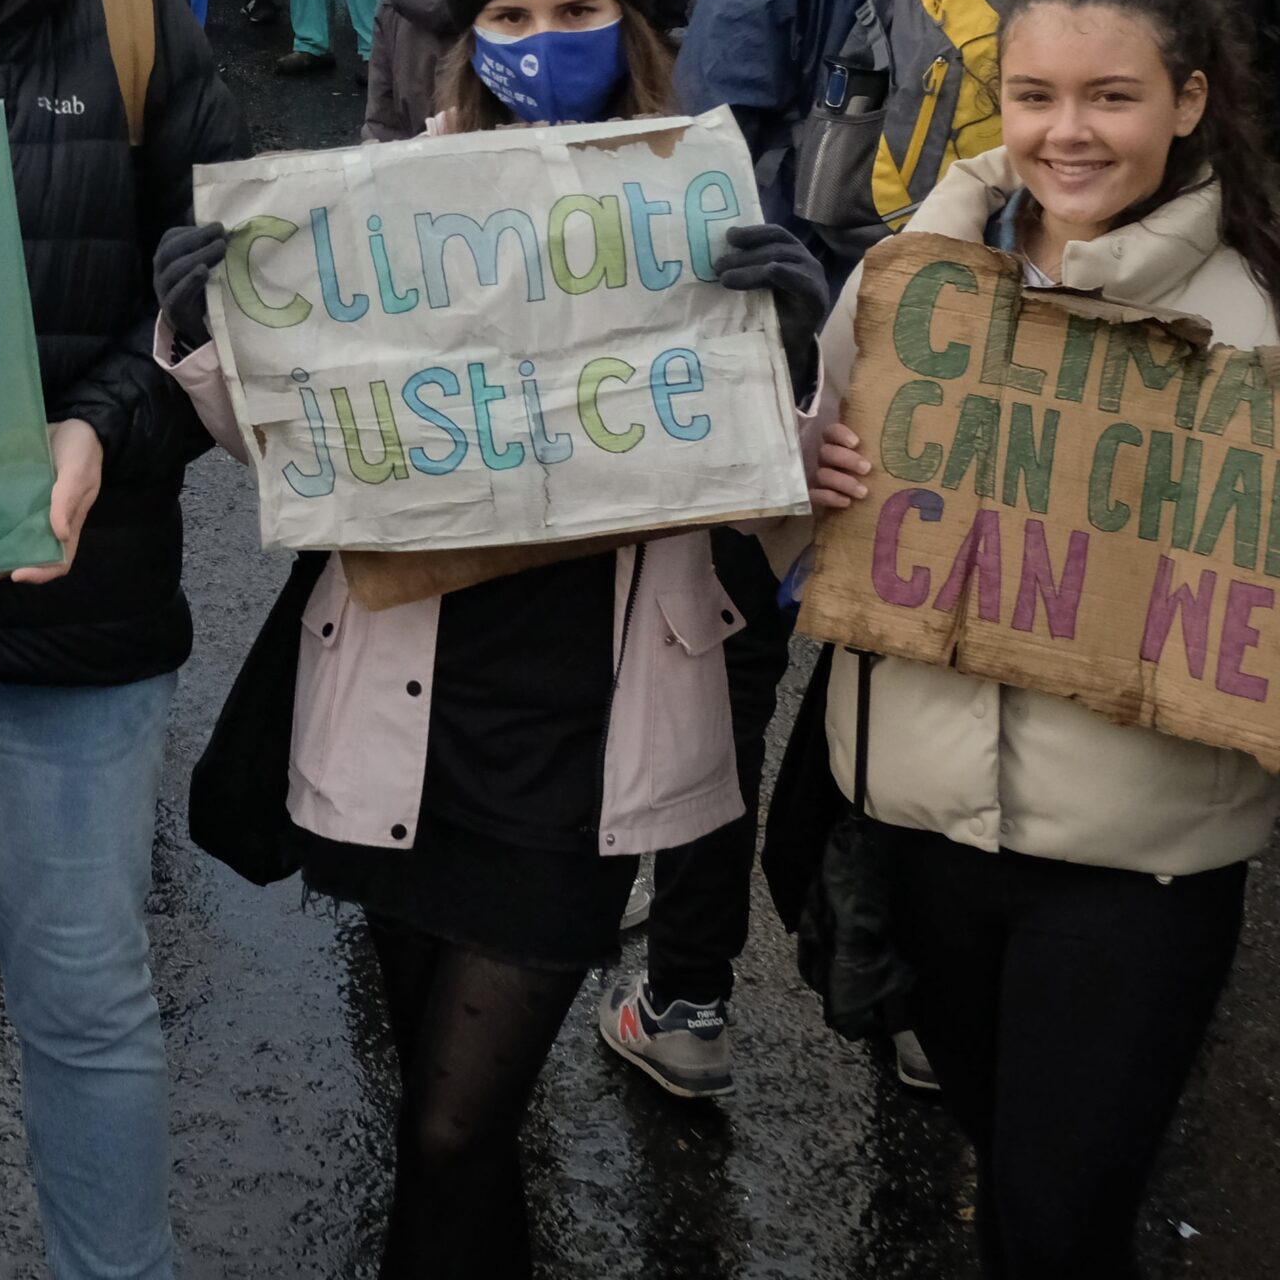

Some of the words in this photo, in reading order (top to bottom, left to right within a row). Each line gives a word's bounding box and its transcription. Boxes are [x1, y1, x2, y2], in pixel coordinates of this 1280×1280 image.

[281, 346, 712, 498] justice
[880, 379, 1061, 515] CAN
[871, 488, 1090, 641] CAN
[1139, 553, 1275, 703] WE
[696, 1009, 716, 1019] new
